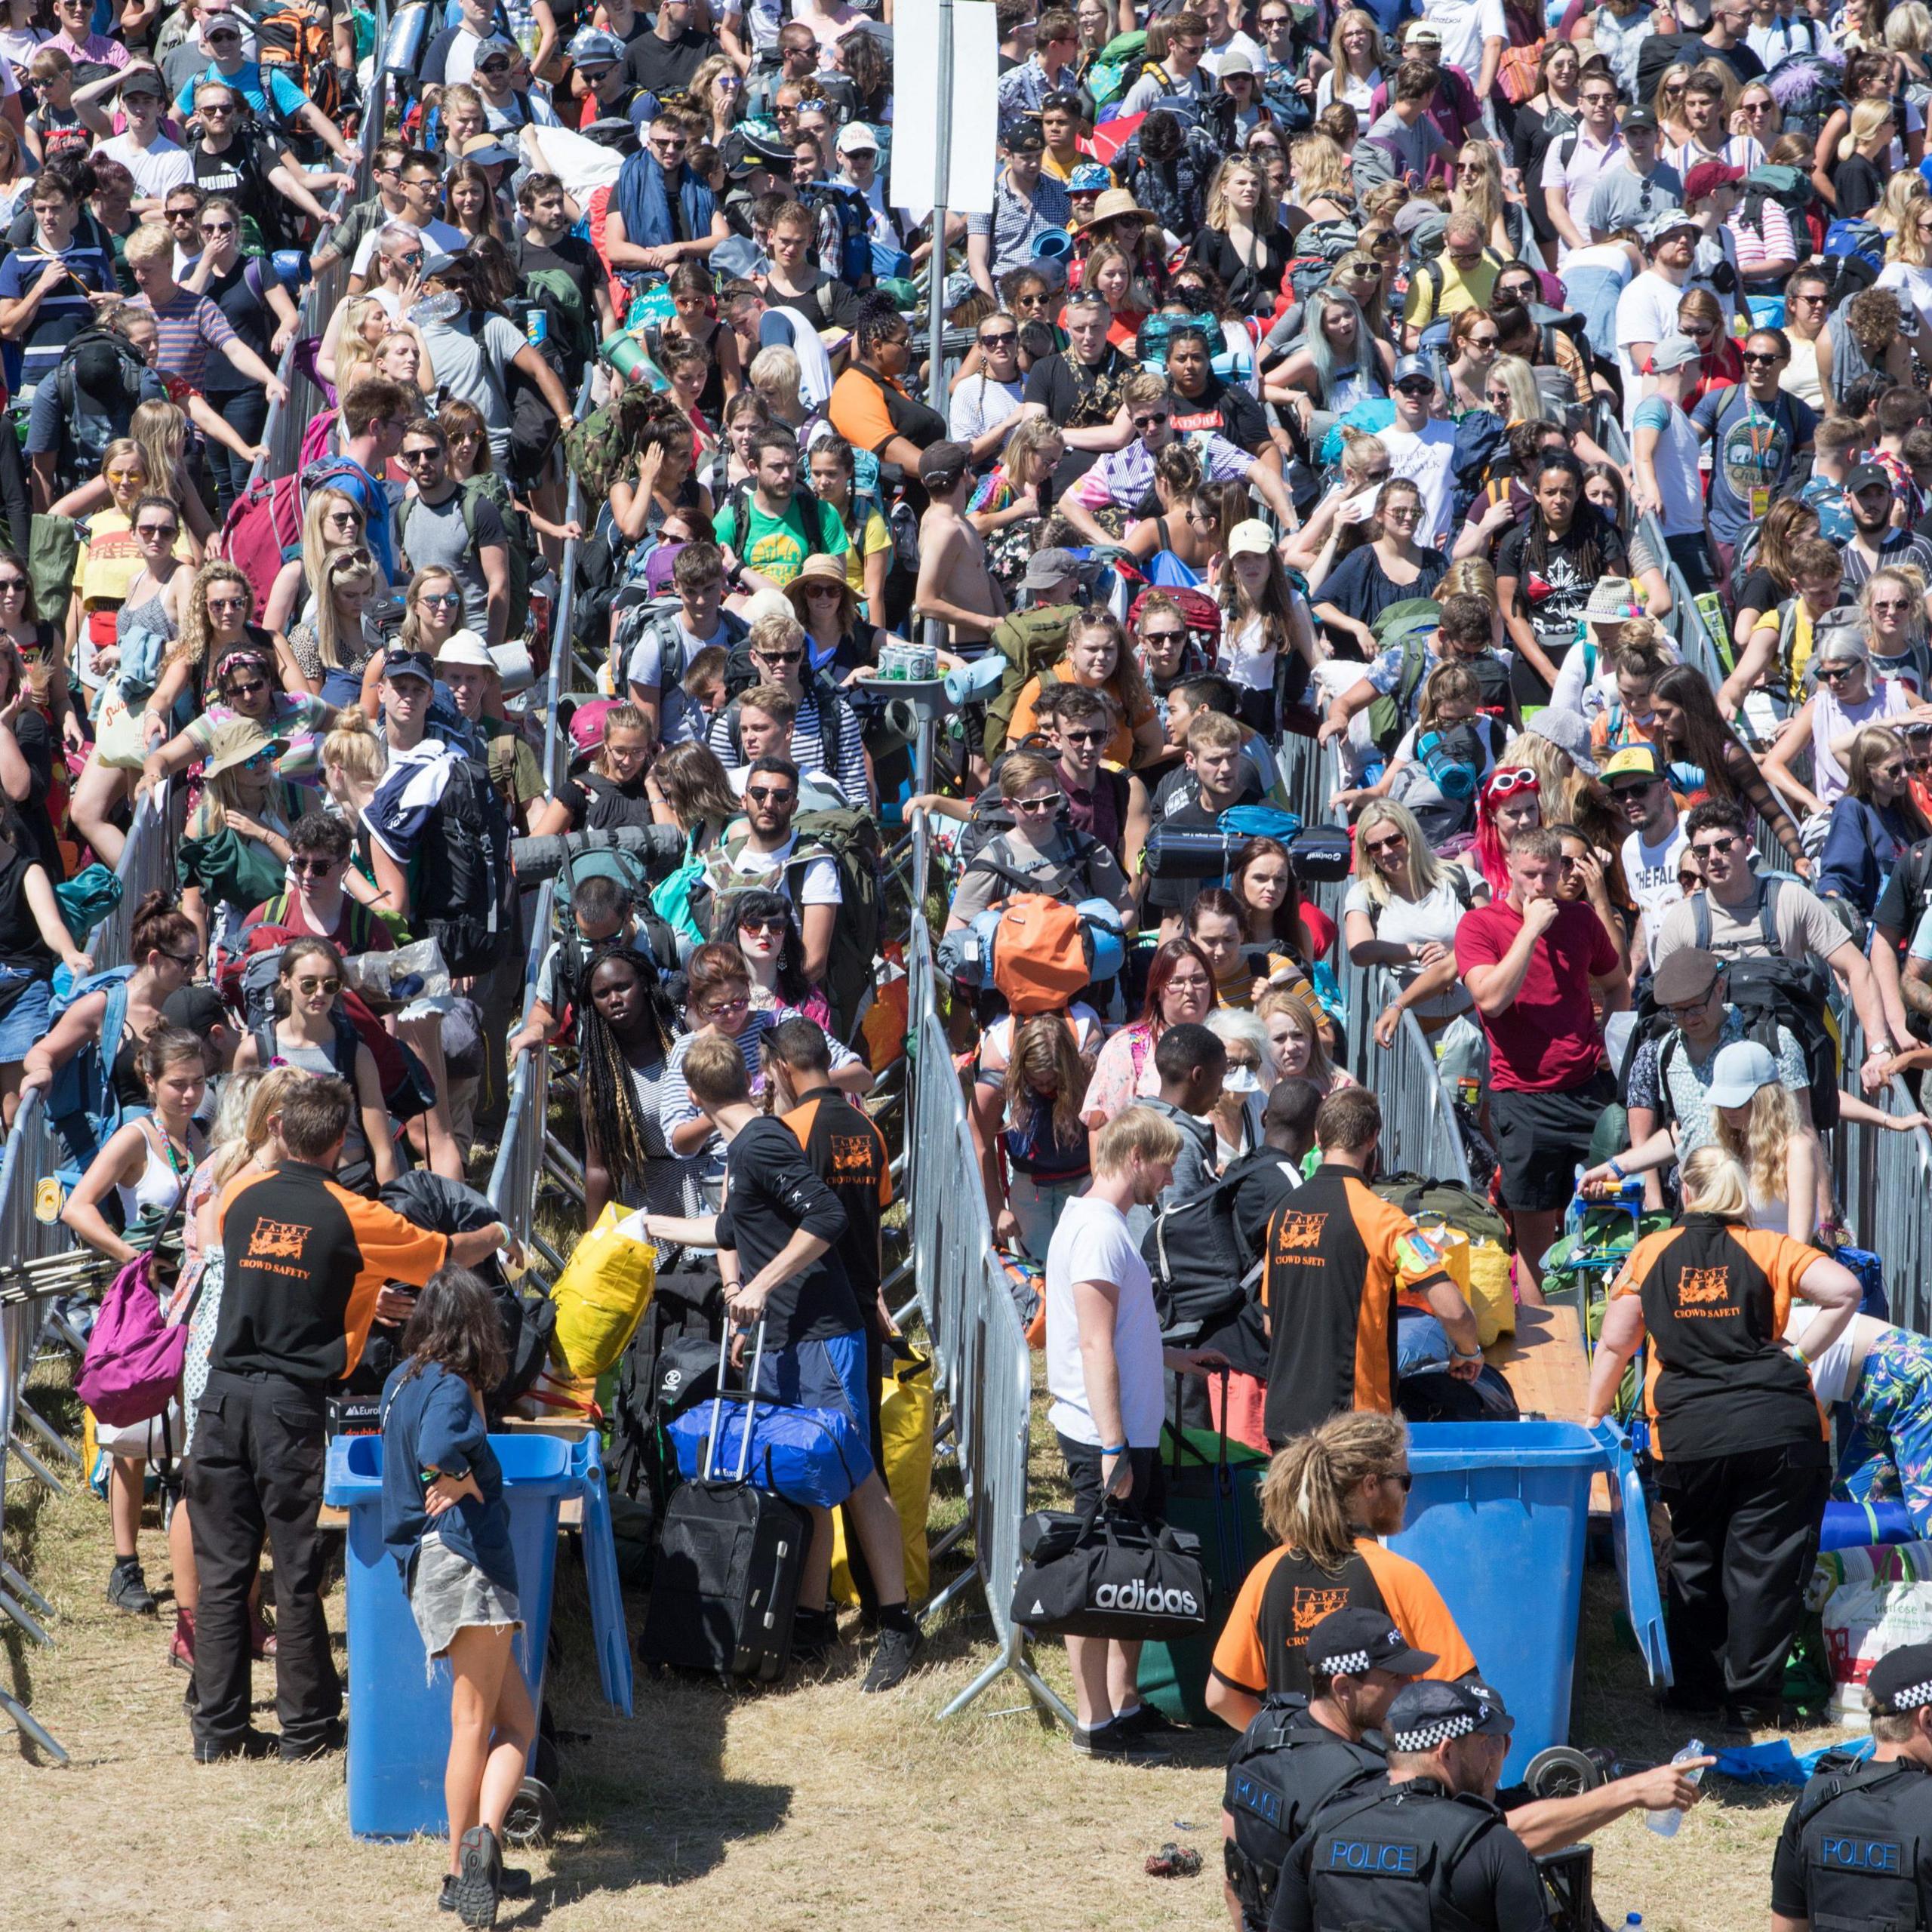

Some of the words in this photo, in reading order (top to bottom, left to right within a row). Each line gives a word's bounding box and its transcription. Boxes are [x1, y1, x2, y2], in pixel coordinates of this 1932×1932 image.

[198, 173, 238, 191] PUMA
[1653, 865, 1678, 887] FAL
[268, 1223, 303, 1236] A.P.S.
[238, 1258, 273, 1273] CROWD
[272, 1264, 311, 1280] SAFETY
[1674, 1309, 1704, 1319] CROWD
[1095, 1578, 1198, 1616] adidas
[1309, 1592, 1341, 1601] A.P.S.
[1234, 1776, 1278, 1822] POLICE
[1330, 1841, 1414, 1872] POLICE
[1822, 1837, 1898, 1871] POLICE
